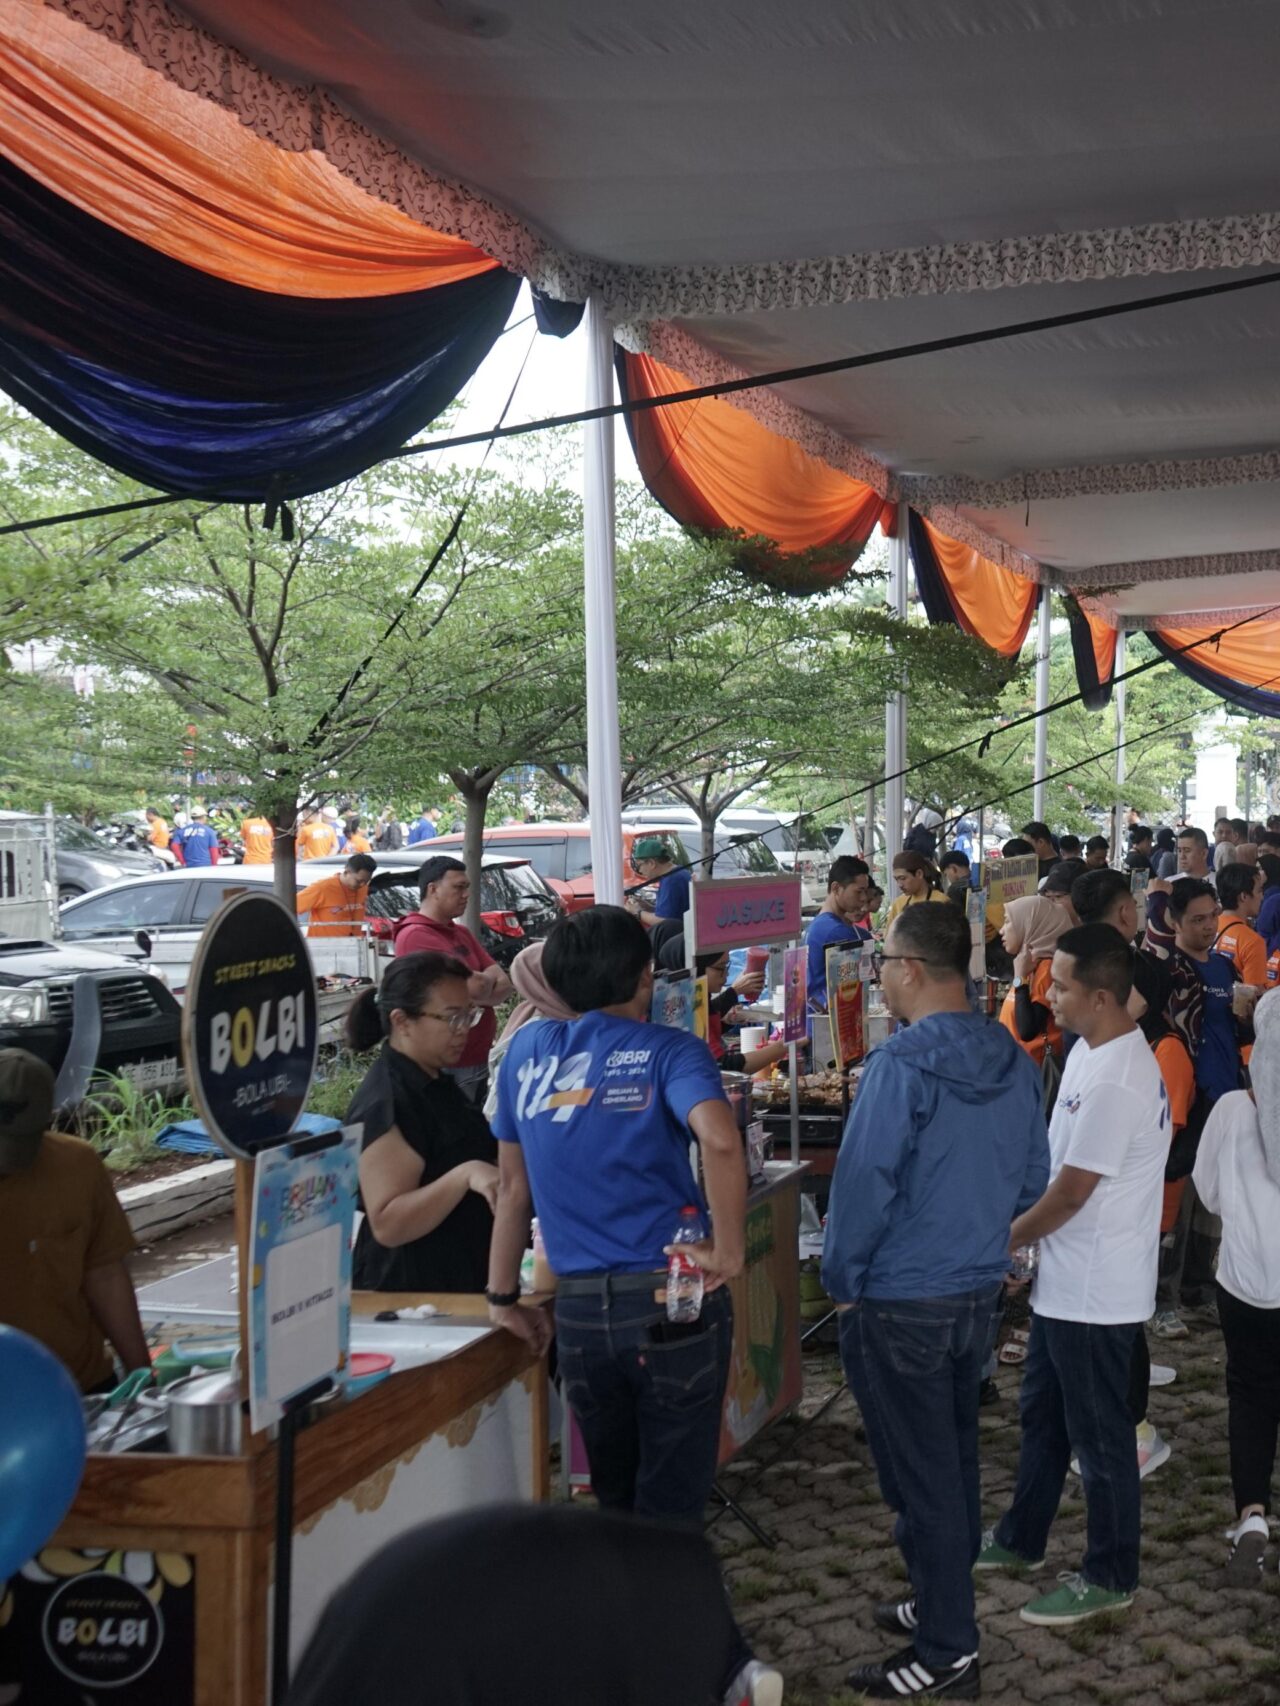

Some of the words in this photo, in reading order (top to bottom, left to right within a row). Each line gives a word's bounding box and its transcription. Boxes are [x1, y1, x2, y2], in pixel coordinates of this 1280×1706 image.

[716, 896, 785, 929] JASUKE
[213, 961, 257, 986] STREET
[257, 953, 296, 976] SNACKS
[209, 989, 306, 1075] BOLBI
[623, 1050, 651, 1064] BRI
[516, 1051, 595, 1122] 129
[57, 1616, 150, 1649] BOLBI
